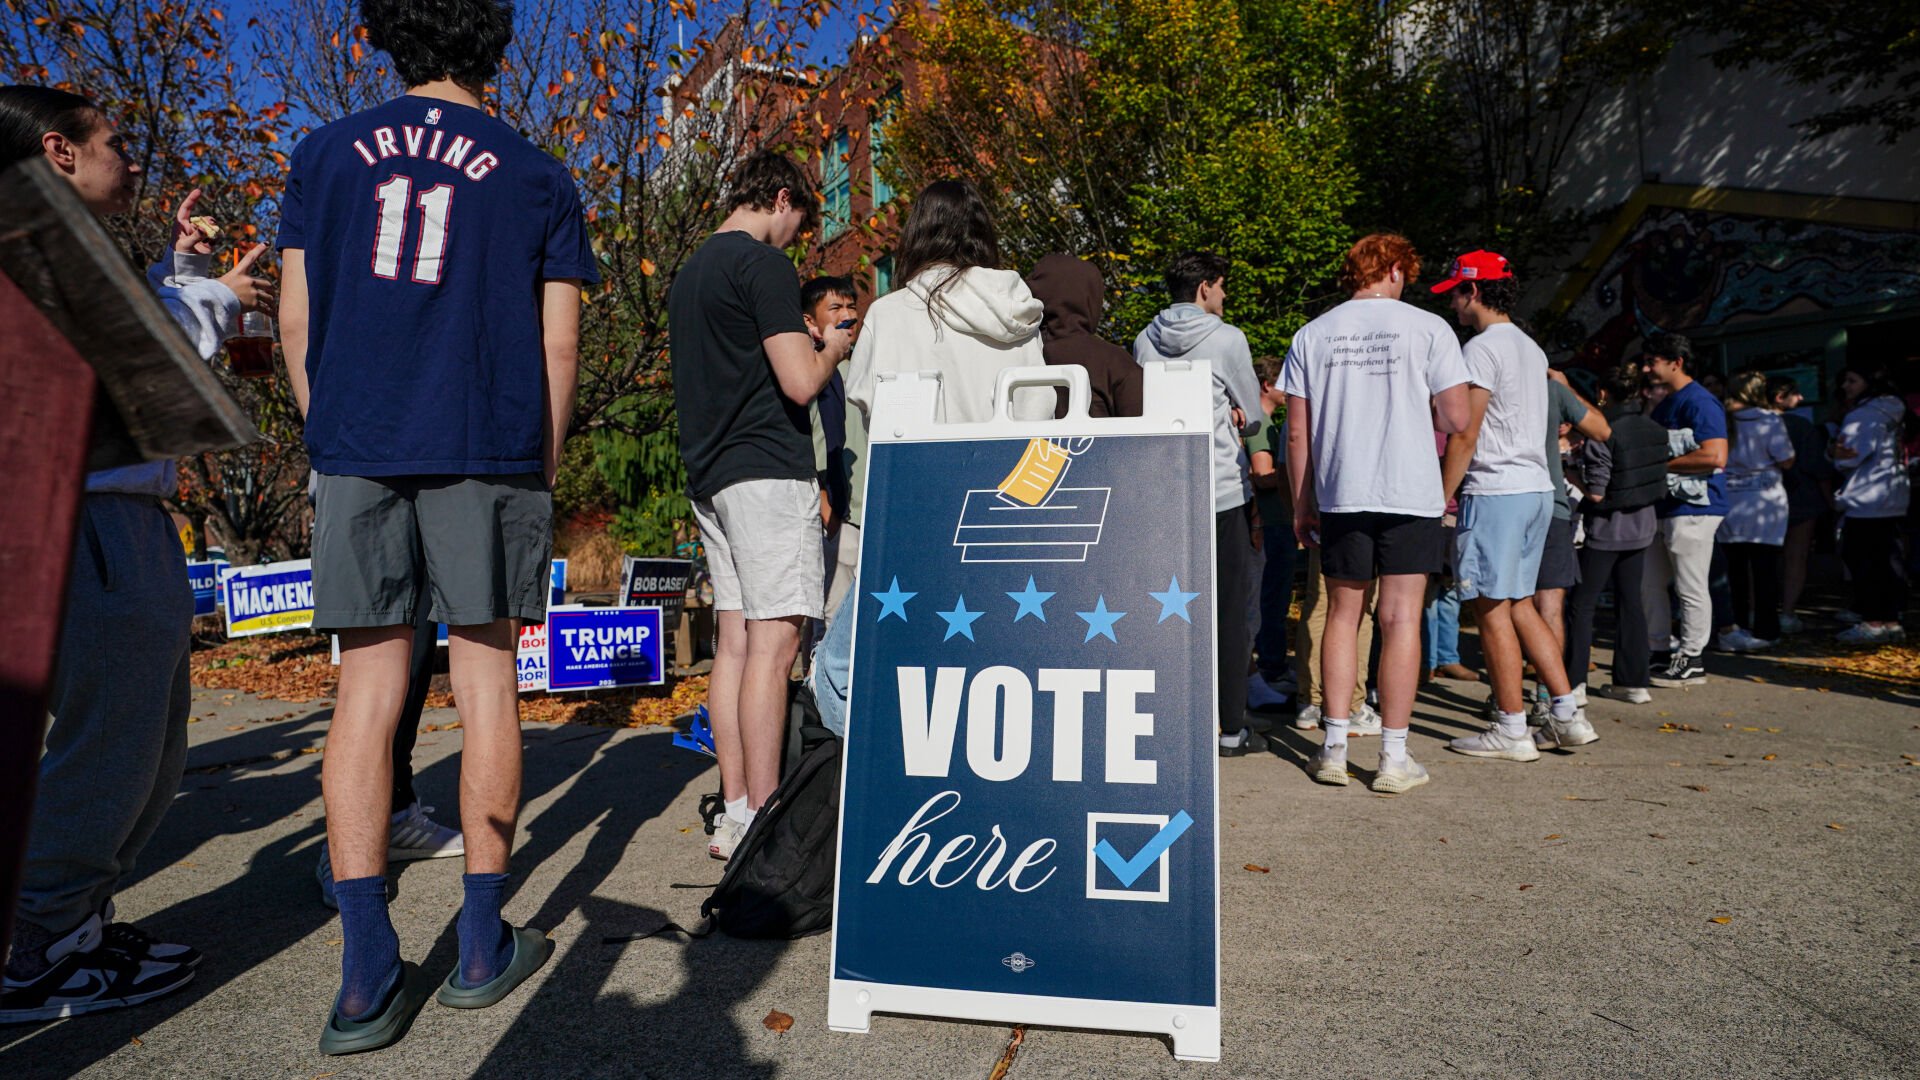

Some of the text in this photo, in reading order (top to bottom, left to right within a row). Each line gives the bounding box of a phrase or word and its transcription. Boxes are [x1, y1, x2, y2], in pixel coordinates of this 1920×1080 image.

[353, 125, 500, 181] IRVING
[372, 174, 455, 285] 11
[1350, 332, 1360, 342] do
[1362, 331, 1373, 341] all
[1375, 331, 1400, 342] things
[1333, 344, 1390, 357] through Christ
[1340, 357, 1384, 369] strengthens
[189, 577, 214, 590] ILD
[633, 577, 688, 591] BOB CASEY
[260, 613, 311, 626] U.S. Congress
[560, 626, 650, 647] TRUMP
[571, 644, 642, 662] VANCE
[583, 662, 609, 670] AMERICA
[896, 665, 1158, 785] VOTE
[865, 790, 1057, 893] here
